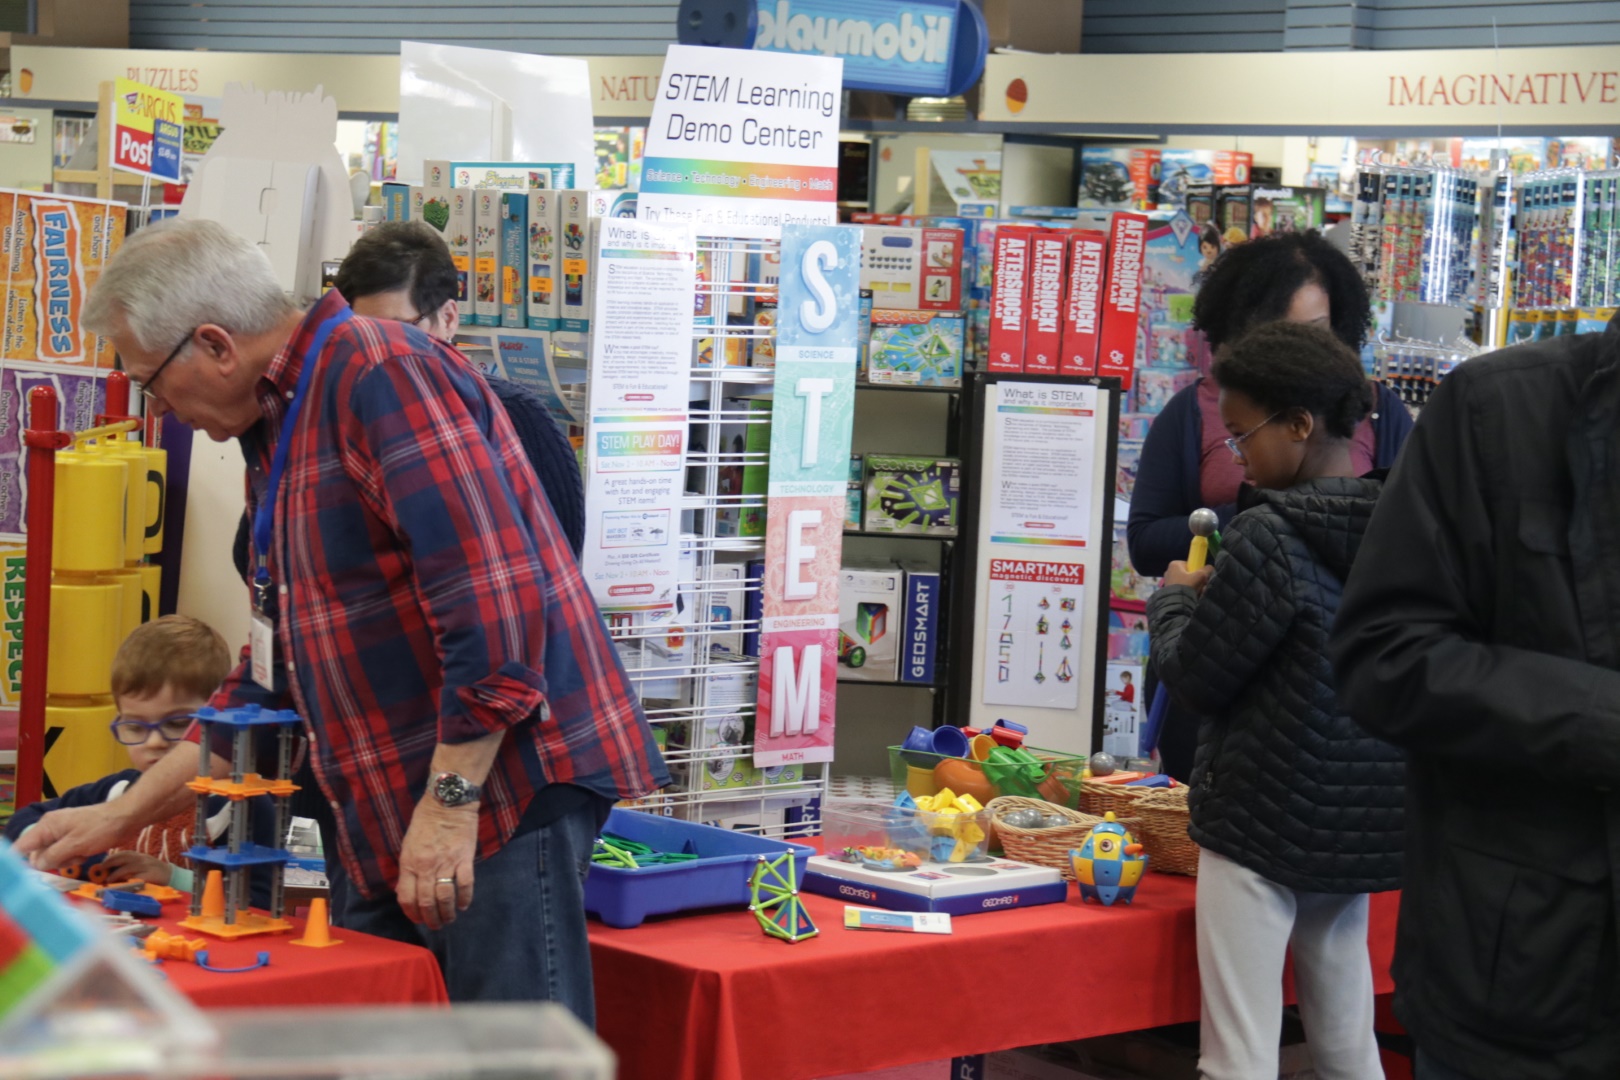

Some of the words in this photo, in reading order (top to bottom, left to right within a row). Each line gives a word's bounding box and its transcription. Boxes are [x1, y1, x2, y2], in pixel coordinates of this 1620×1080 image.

[126, 67, 199, 92] PUZZLES
[1388, 72, 1618, 107] IMAGINATIVE
[666, 74, 730, 103] STEM
[736, 78, 834, 118] Learning
[666, 114, 732, 144] Demo
[742, 118, 823, 150] Center
[646, 168, 682, 182] Science
[691, 171, 742, 188] Technology
[749, 174, 800, 191] Engineering
[808, 178, 834, 191] Math
[16, 210, 27, 234] Avoid
[94, 216, 102, 232] and
[645, 206, 661, 223] Try
[727, 210, 782, 226] Educational
[608, 227, 637, 240] What
[12, 237, 24, 272] blaming
[92, 235, 102, 258] share
[1111, 219, 1126, 284] EARTHQUAKE
[996, 238, 1006, 300] EARTHQUAKE
[1032, 240, 1044, 301] EARTHQUAKE
[1070, 240, 1082, 302] EARTHQUAKE
[1117, 219, 1145, 313] AFTERSHOCK!
[44, 212, 72, 354] FAIRNESS
[800, 240, 838, 334] S
[1002, 238, 1026, 331] AFTERSHOCK!
[1038, 240, 1063, 333] AFTERSHOCK!
[1076, 240, 1102, 334] AFTERSHOCK!
[1110, 285, 1118, 304] LAB
[17, 298, 28, 322] Listen
[875, 310, 928, 322] GEOMAG
[1031, 302, 1040, 320] LAB
[1069, 302, 1077, 321] LAB
[16, 324, 24, 333] to
[15, 335, 24, 348] the
[98, 334, 108, 352] ules
[798, 350, 834, 360] SCIENCE
[76, 382, 87, 408] things
[1004, 388, 1034, 399] What
[1038, 390, 1047, 400] is
[1051, 390, 1084, 400] STEM
[76, 410, 86, 432] bette
[795, 378, 834, 470] T
[601, 435, 630, 450] STEM
[632, 434, 655, 448] PLAY
[658, 434, 680, 448] DAY!
[873, 460, 925, 472] GEOMAG
[780, 485, 834, 493] TECHNOLOGY
[784, 509, 822, 600] E
[992, 560, 1080, 576] SMARTMAX
[992, 572, 1032, 580] magnetic
[1036, 574, 1078, 584] discovery
[773, 618, 826, 628] ENGINEERING
[912, 582, 930, 678] GEOSMART
[770, 644, 822, 738] M
[782, 753, 804, 762] MATH
[839, 884, 870, 899] GEOMAG
[982, 895, 1012, 908] GEOMAG
